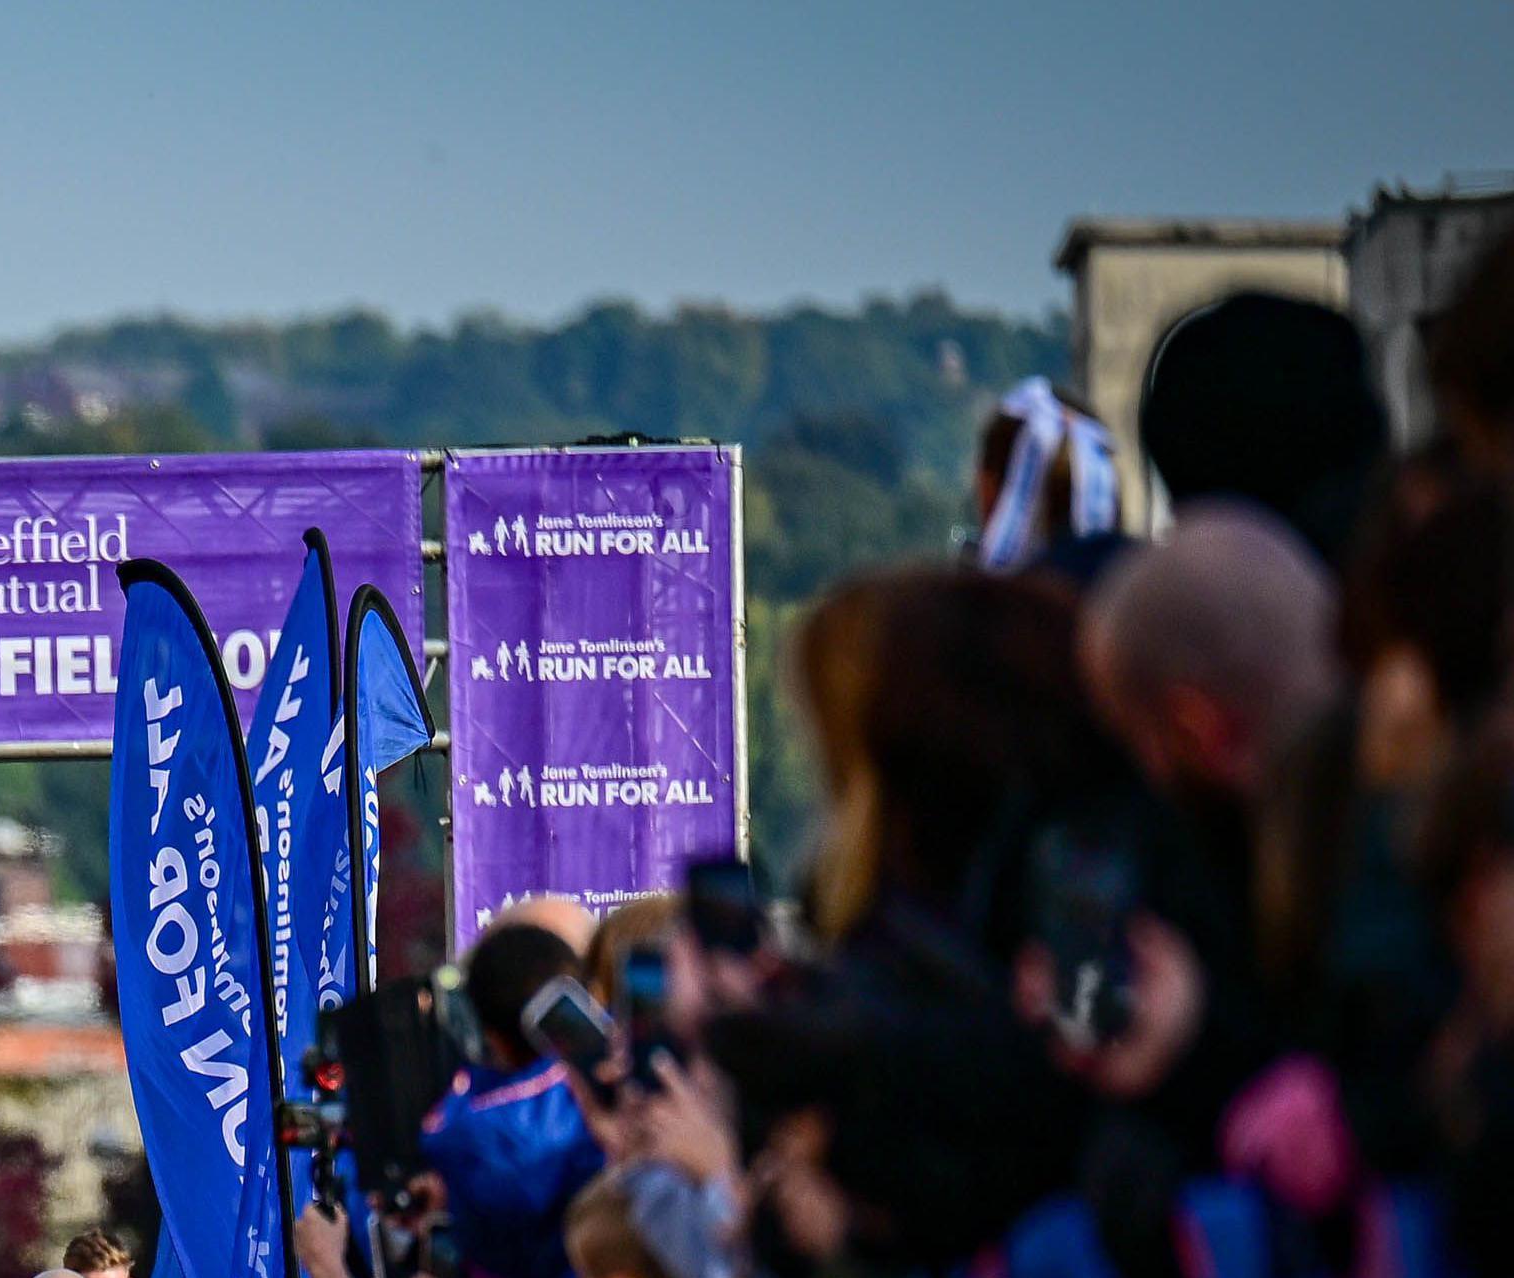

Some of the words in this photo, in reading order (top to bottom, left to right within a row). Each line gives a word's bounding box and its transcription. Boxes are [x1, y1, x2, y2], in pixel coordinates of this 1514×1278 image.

[536, 513, 573, 530] Jane
[577, 512, 664, 529] Tomlinson's
[535, 531, 596, 557] RUN
[600, 530, 655, 556] FOR
[661, 529, 710, 554] ALL
[538, 639, 575, 655] Jane
[578, 637, 666, 654] Tomlinson's
[538, 656, 597, 682] RUN
[602, 655, 657, 681] FOR
[663, 654, 712, 680] ALL
[540, 765, 578, 781] Jane
[580, 762, 668, 779] Tomlinson's
[540, 781, 599, 807] RUN
[605, 780, 659, 806] FOR
[665, 780, 714, 804] ALL
